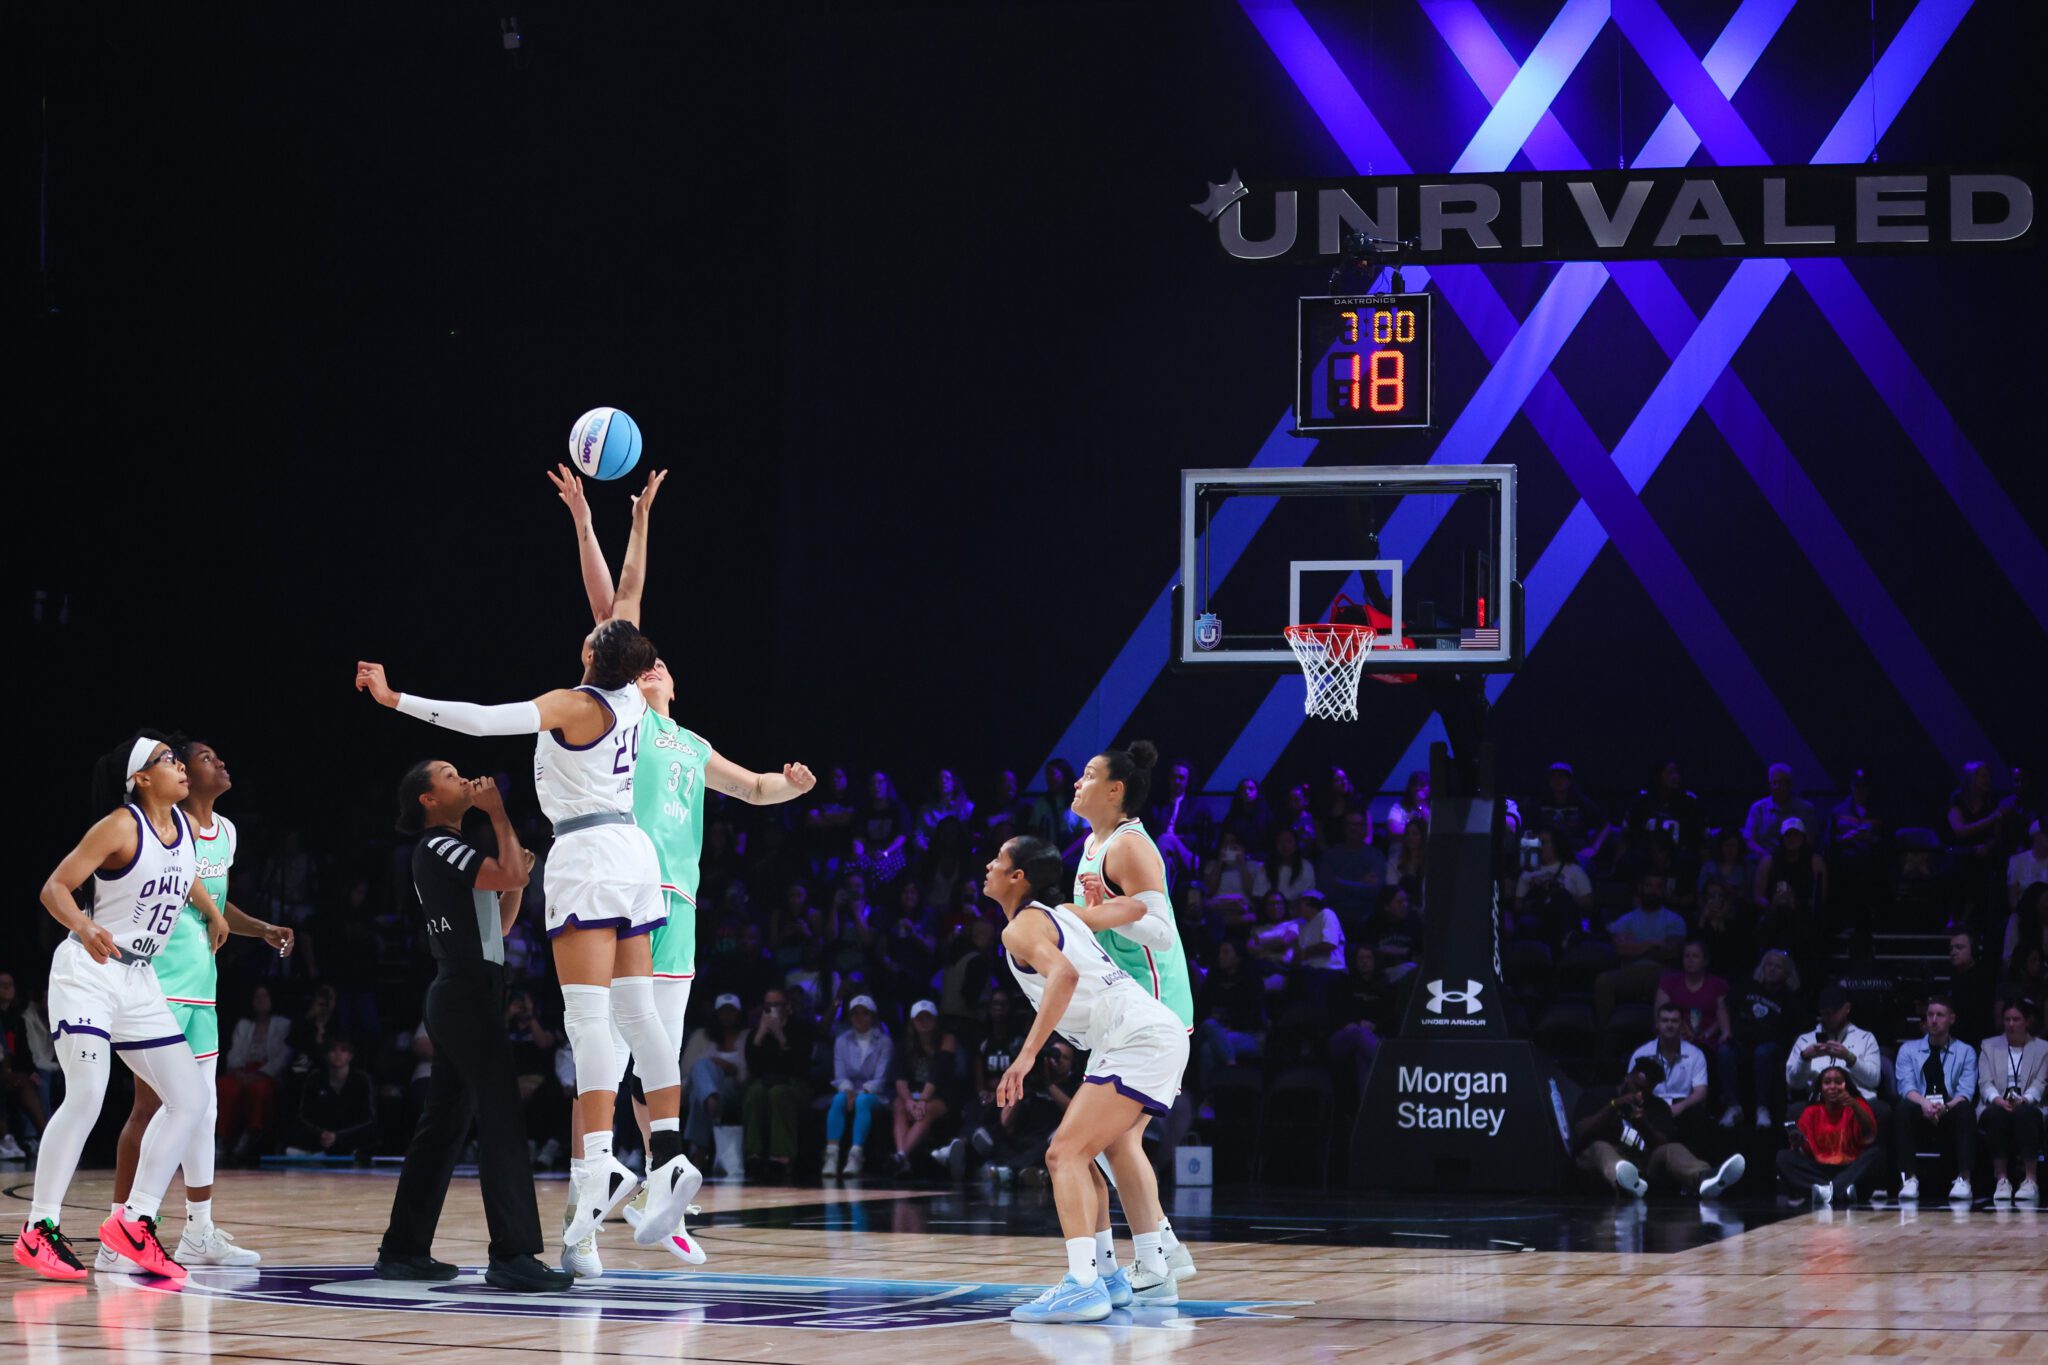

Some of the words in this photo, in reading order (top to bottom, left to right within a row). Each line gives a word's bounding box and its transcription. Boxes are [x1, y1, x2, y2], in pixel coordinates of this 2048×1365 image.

[1217, 174, 2034, 260] UNRIVALED
[1334, 297, 1396, 305] DAKTRONICS
[1350, 350, 1405, 412] 18
[667, 761, 696, 797] 31
[663, 801, 689, 825] ally
[140, 875, 188, 900] OWLS
[147, 903, 177, 935] 15
[132, 937, 160, 957] ally
[1421, 1018, 1450, 1026] UNDER
[1450, 1018, 1486, 1027] ARMOUR
[1398, 1065, 1508, 1101] Morgan
[1397, 1101, 1506, 1137] Stanley
